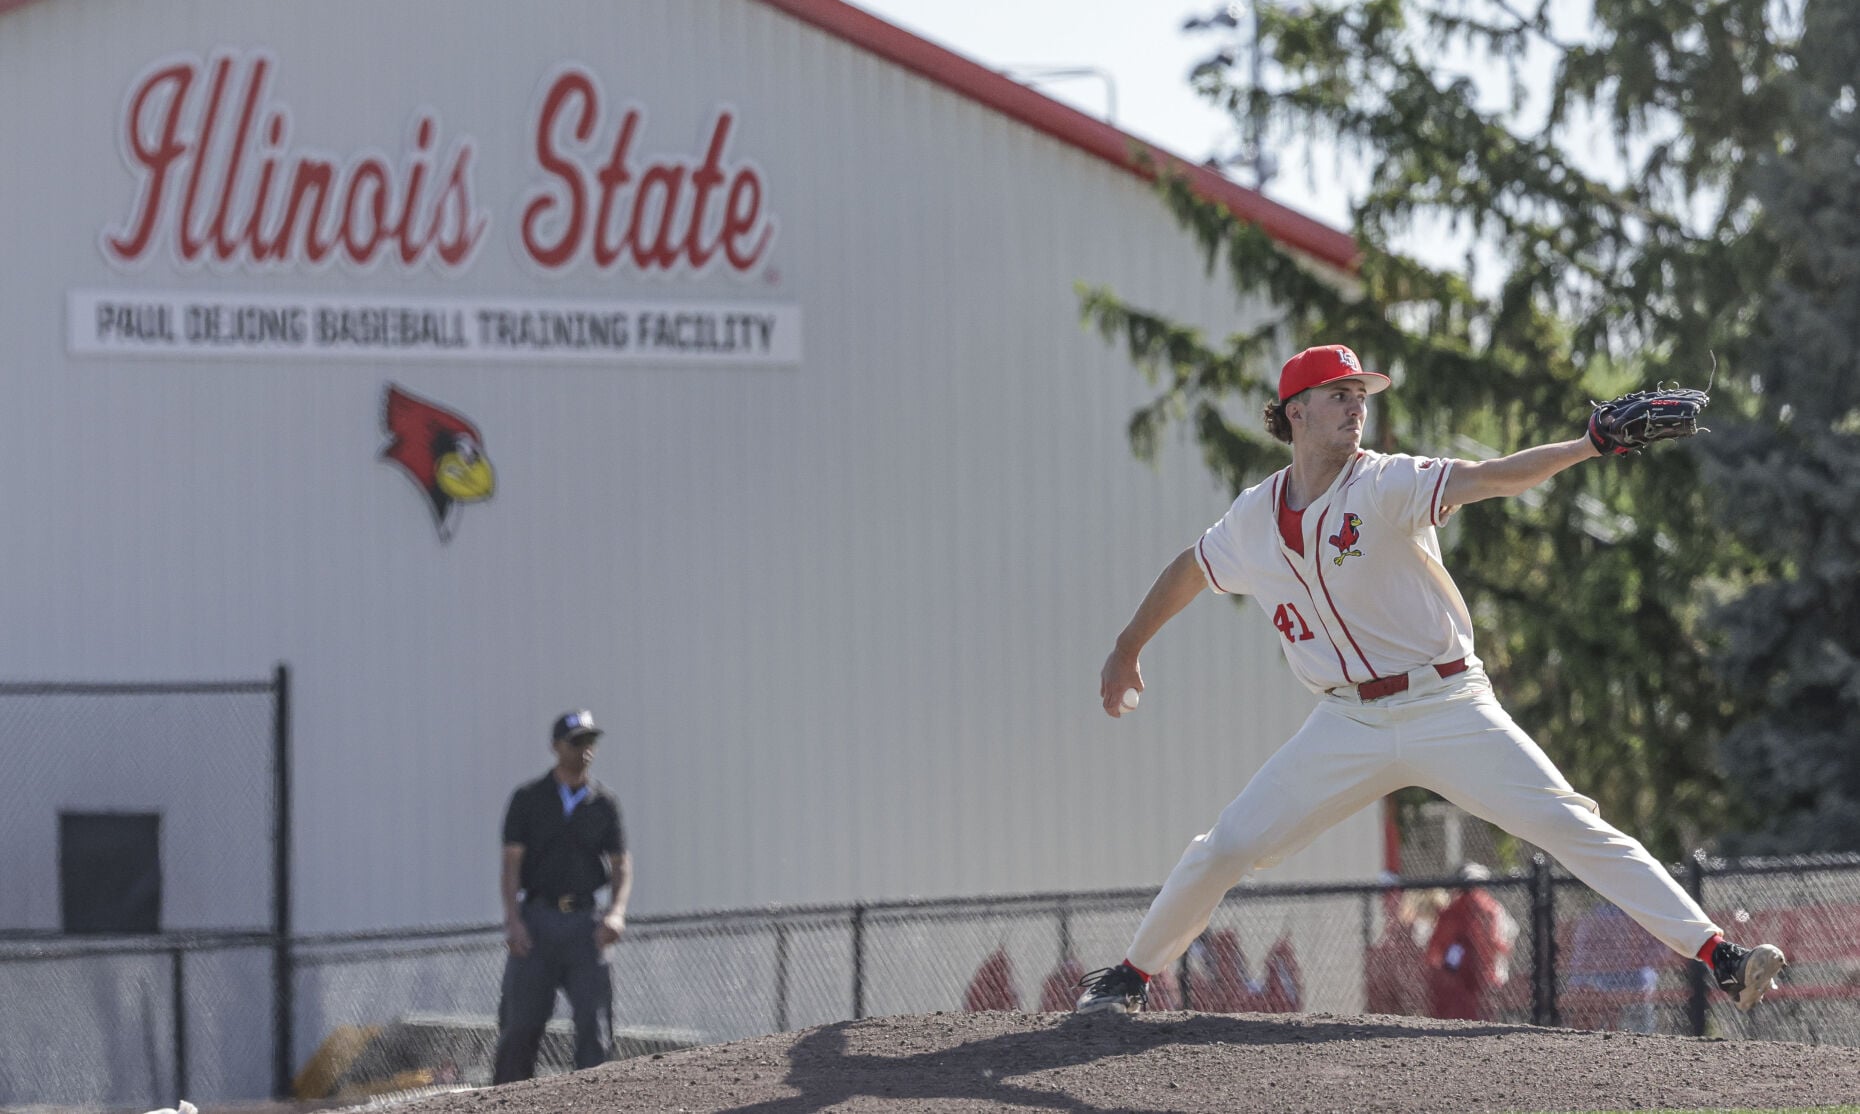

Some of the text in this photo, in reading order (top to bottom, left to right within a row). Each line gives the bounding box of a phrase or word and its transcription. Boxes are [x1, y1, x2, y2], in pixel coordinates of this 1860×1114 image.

[108, 56, 775, 272] Illinois State
[97, 303, 776, 354] PAUL DEJONG BASEBALL TRAINING FACILITY
[1273, 602, 1315, 643] 41
